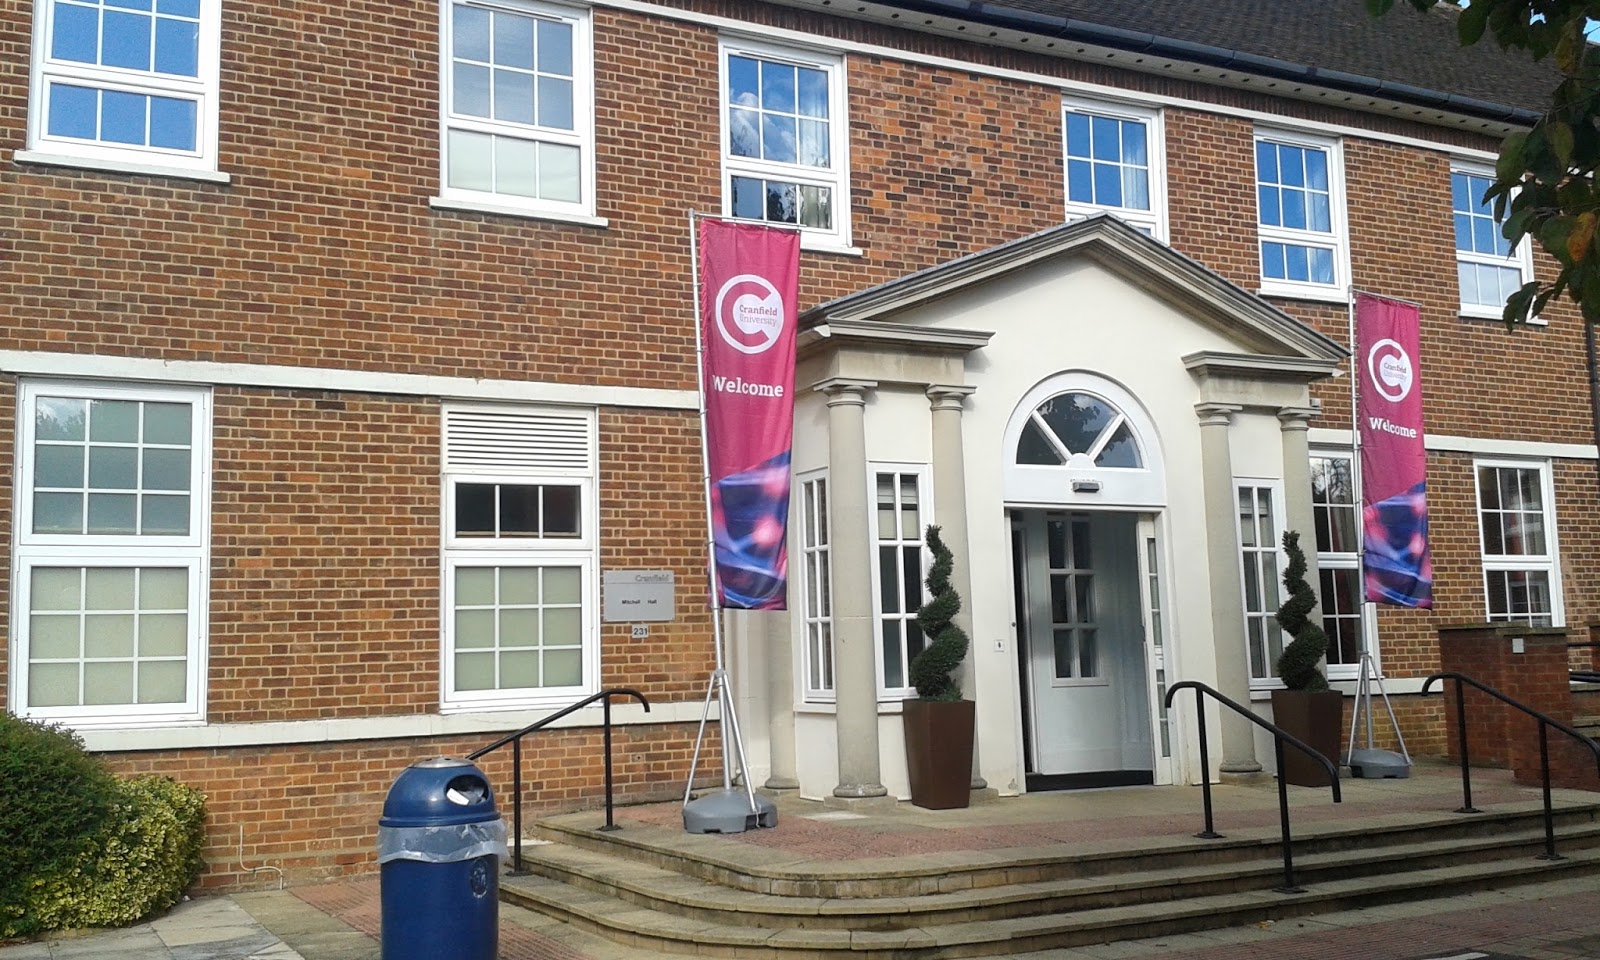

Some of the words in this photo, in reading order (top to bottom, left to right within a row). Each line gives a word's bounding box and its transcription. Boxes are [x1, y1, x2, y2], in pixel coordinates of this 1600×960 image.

[739, 304, 778, 316] Cranfield
[740, 314, 777, 327] University
[712, 374, 784, 397] Welcome
[1369, 417, 1417, 439] Welcome
[633, 627, 648, 636] 231
